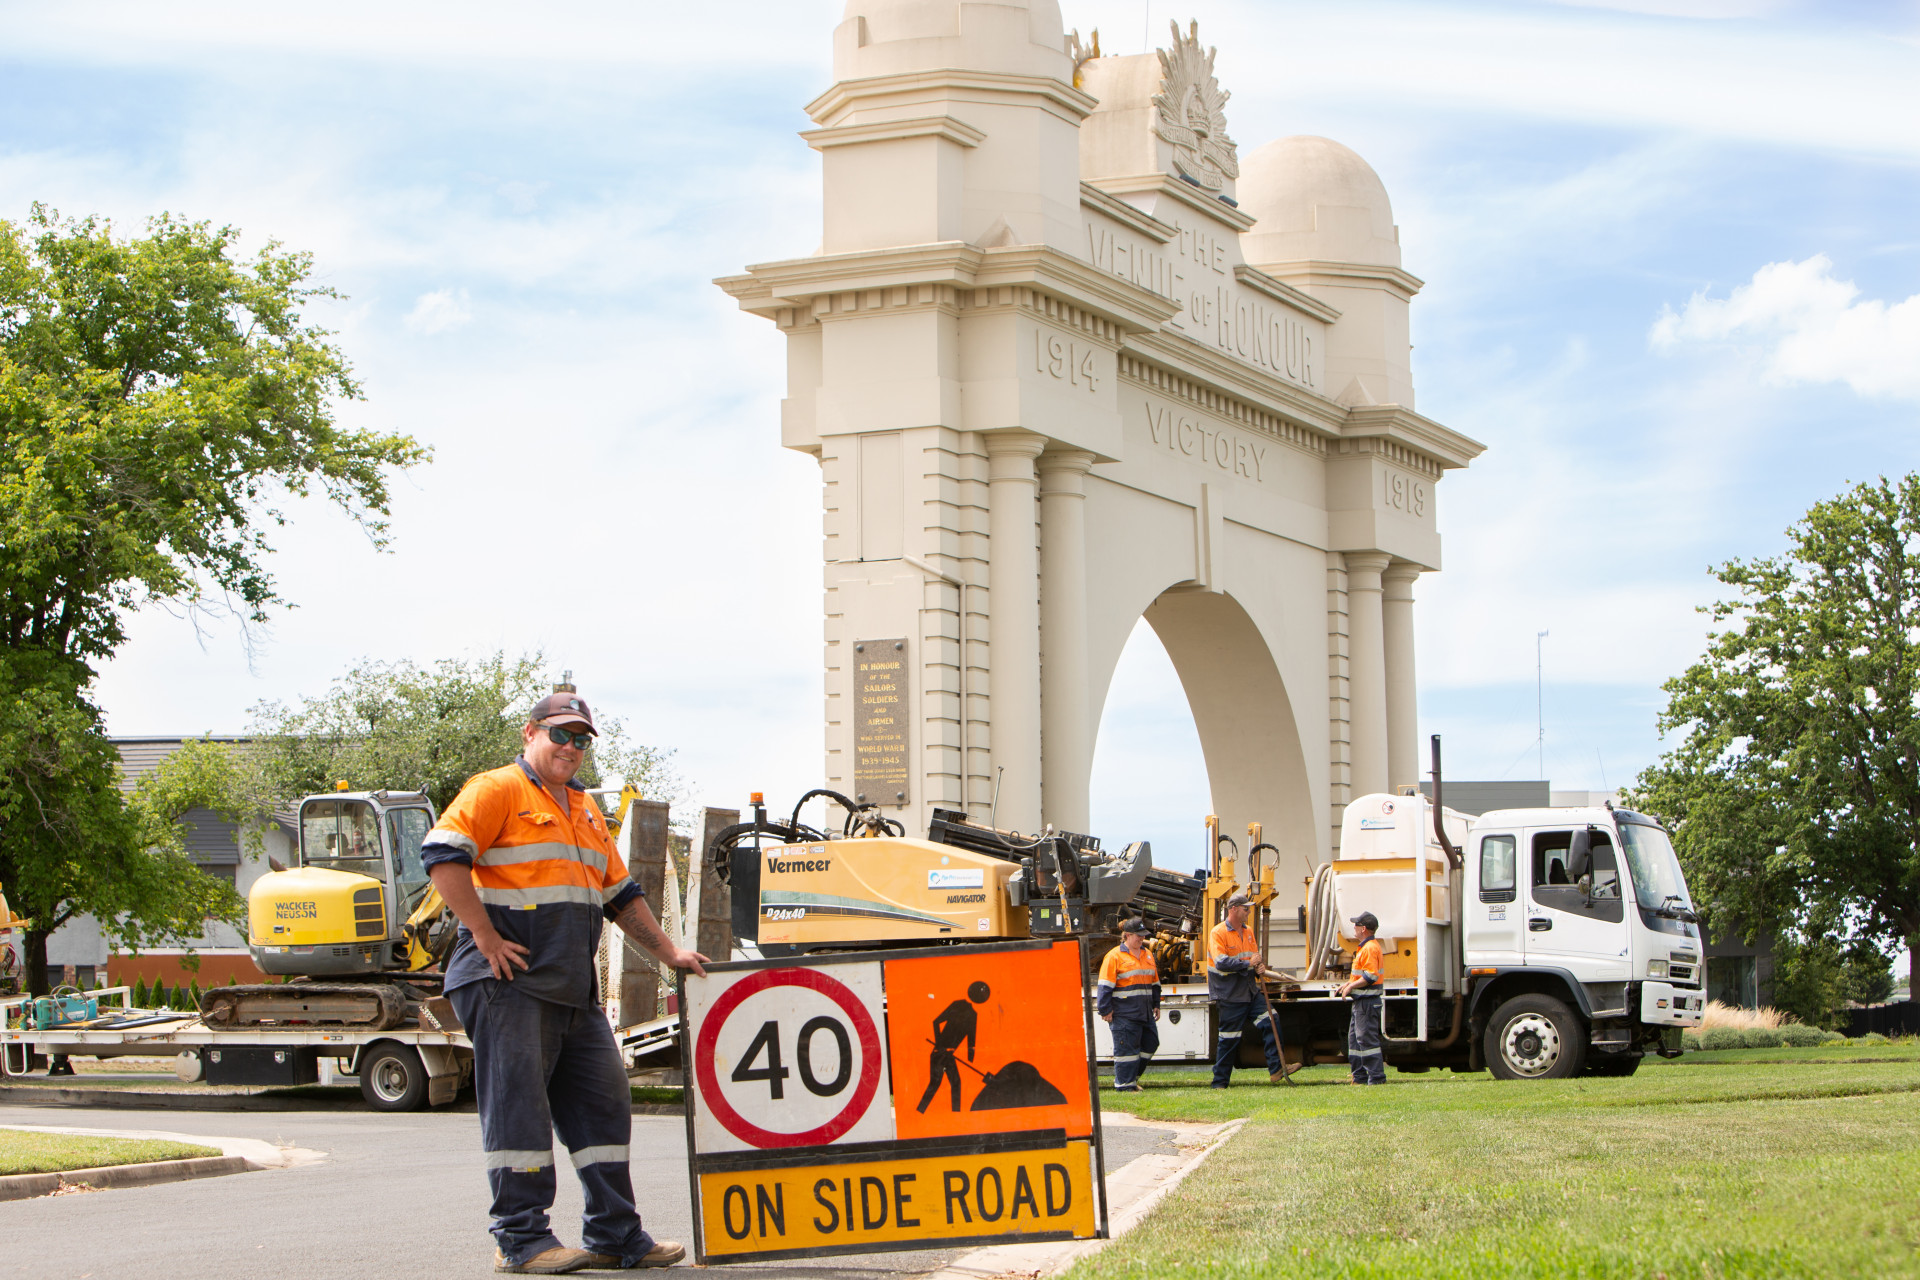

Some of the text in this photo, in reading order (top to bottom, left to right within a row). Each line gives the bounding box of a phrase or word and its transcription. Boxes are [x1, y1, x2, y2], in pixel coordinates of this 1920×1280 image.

[1175, 219, 1225, 275] THE
[1191, 290, 1212, 327] OF
[1217, 285, 1314, 388] HONOUR
[1036, 327, 1100, 393] 1914
[1145, 401, 1266, 483] VICTORY
[1384, 469, 1424, 518] 1919
[860, 661, 900, 671] IN HONOUR
[864, 683, 896, 692] SAILORS
[862, 695, 898, 704] SOLDIERS
[867, 717, 894, 725] AIRMEN
[858, 744, 882, 753] WORLD
[883, 744, 899, 752] WAR
[861, 756, 900, 765] 1939-1945
[767, 857, 831, 873] Vermeer
[946, 893, 987, 904] NAVIGATOR
[275, 901, 317, 910] WACKER
[276, 910, 317, 919] NEUSON
[766, 907, 806, 921] D24x40
[731, 1015, 853, 1100] 40
[723, 1162, 1072, 1241] ON SIDE ROAD
